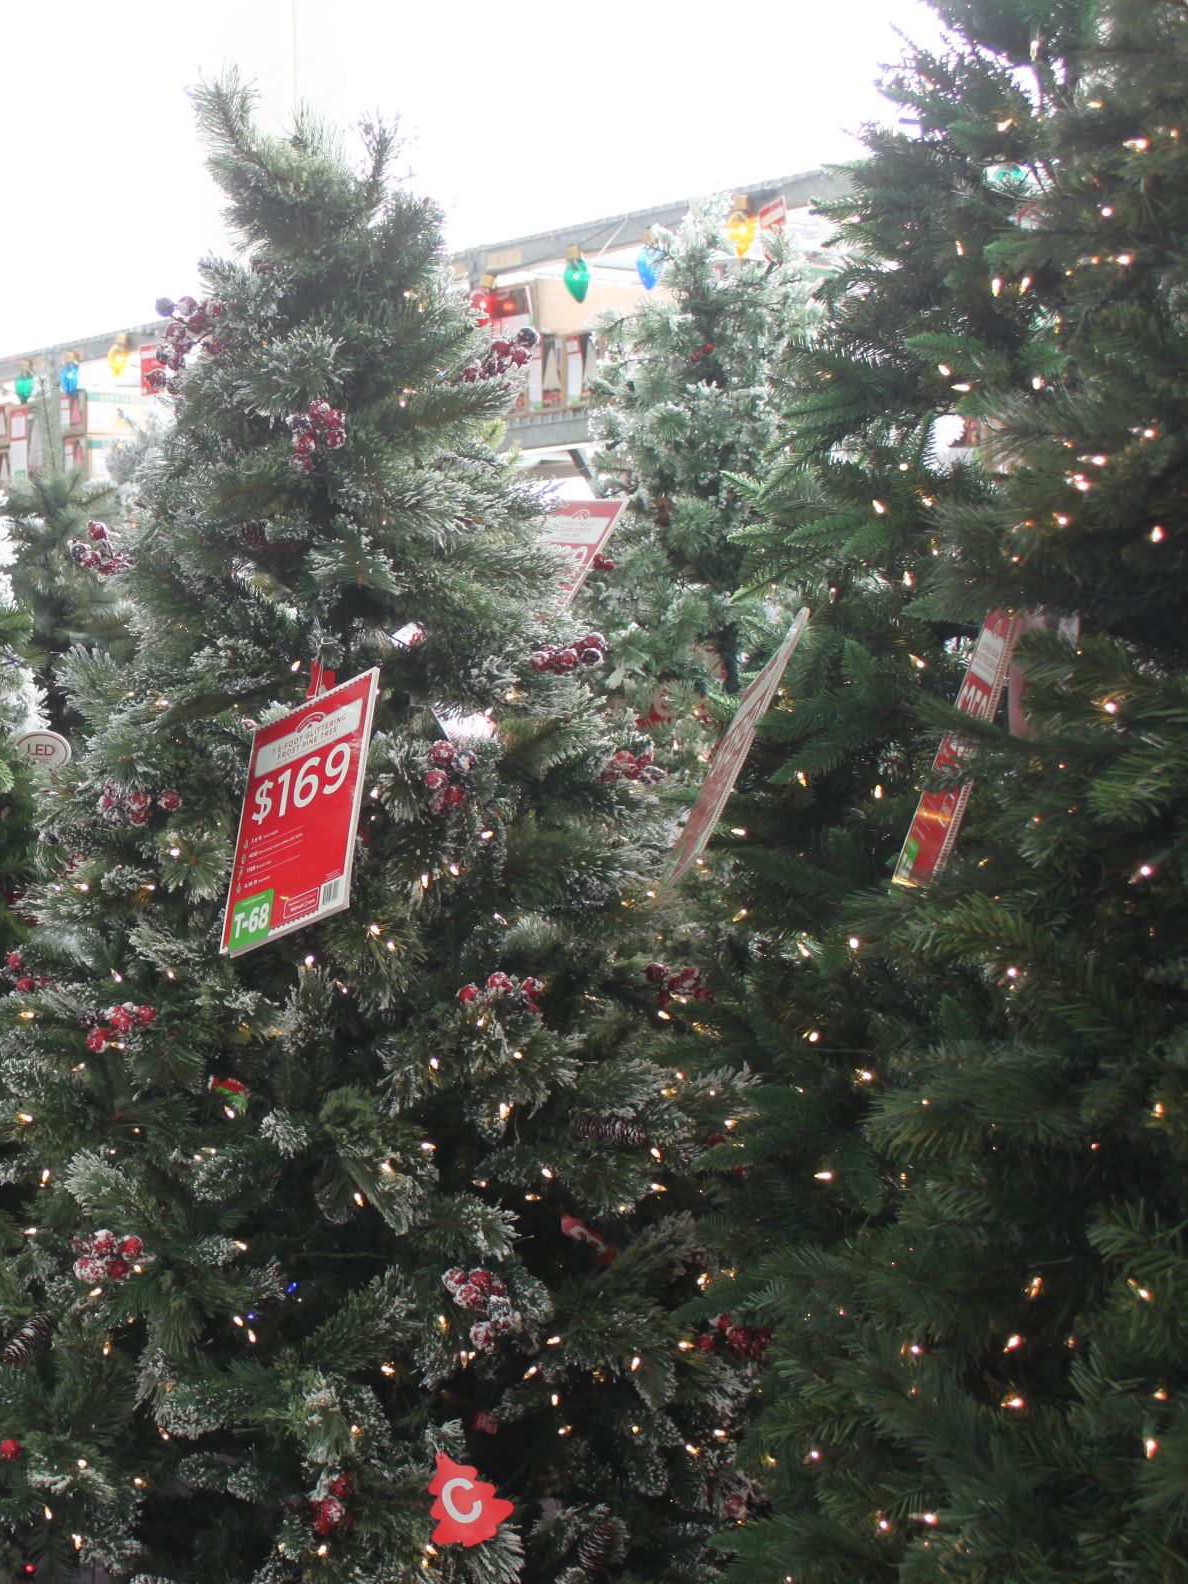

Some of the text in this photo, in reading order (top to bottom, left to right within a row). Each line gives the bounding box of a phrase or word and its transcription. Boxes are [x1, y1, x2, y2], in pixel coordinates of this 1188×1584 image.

[277, 725, 339, 761] FROST PINE TREE
[305, 713, 347, 738] GLITTERING
[27, 744, 55, 756] LED
[251, 742, 351, 825] $169
[233, 902, 270, 939] T-68
[441, 1477, 482, 1523] C
